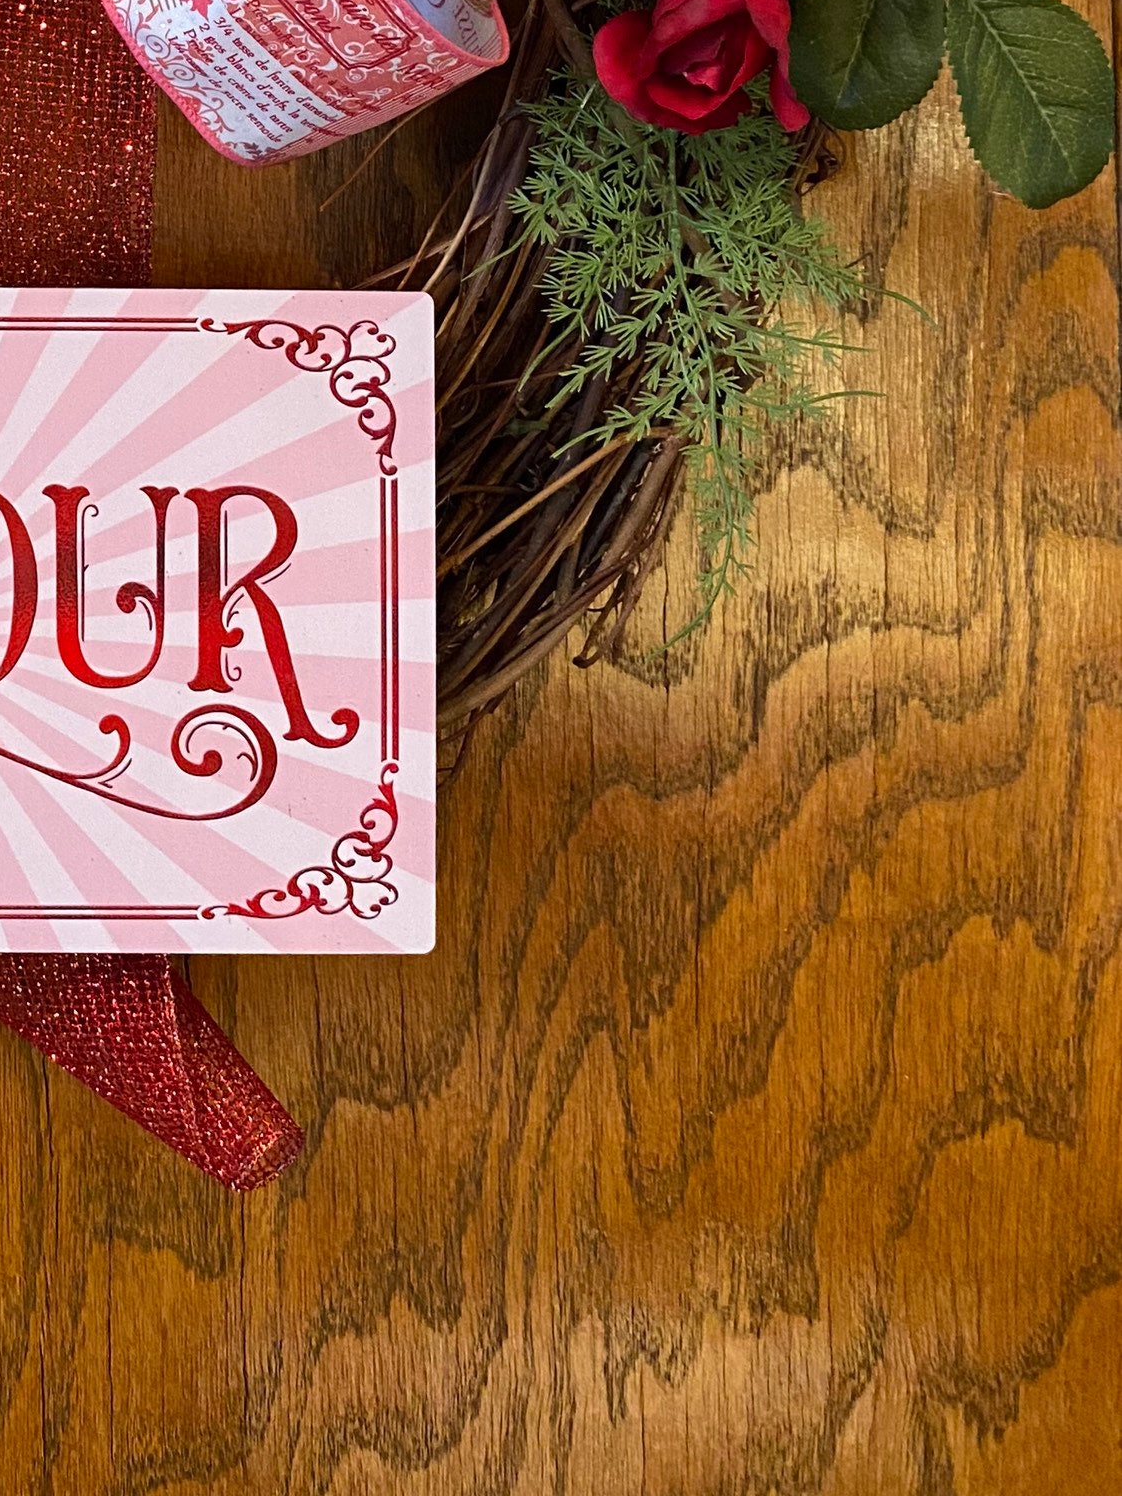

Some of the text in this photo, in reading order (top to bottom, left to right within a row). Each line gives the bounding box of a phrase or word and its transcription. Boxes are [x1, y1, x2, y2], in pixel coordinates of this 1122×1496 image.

[198, 23, 210, 32] 2
[203, 37, 225, 54] gros
[213, 16, 234, 36] 3/4
[232, 37, 254, 58] tasse
[256, 60, 268, 72] de
[265, 71, 295, 95] farine
[226, 53, 255, 82] blancs
[214, 67, 227, 76] de
[228, 77, 254, 100] crème
[255, 104, 269, 112] de
[208, 80, 220, 88] de
[223, 90, 245, 110] sucre
[246, 113, 282, 142] semoule
[288, 109, 300, 119] la
